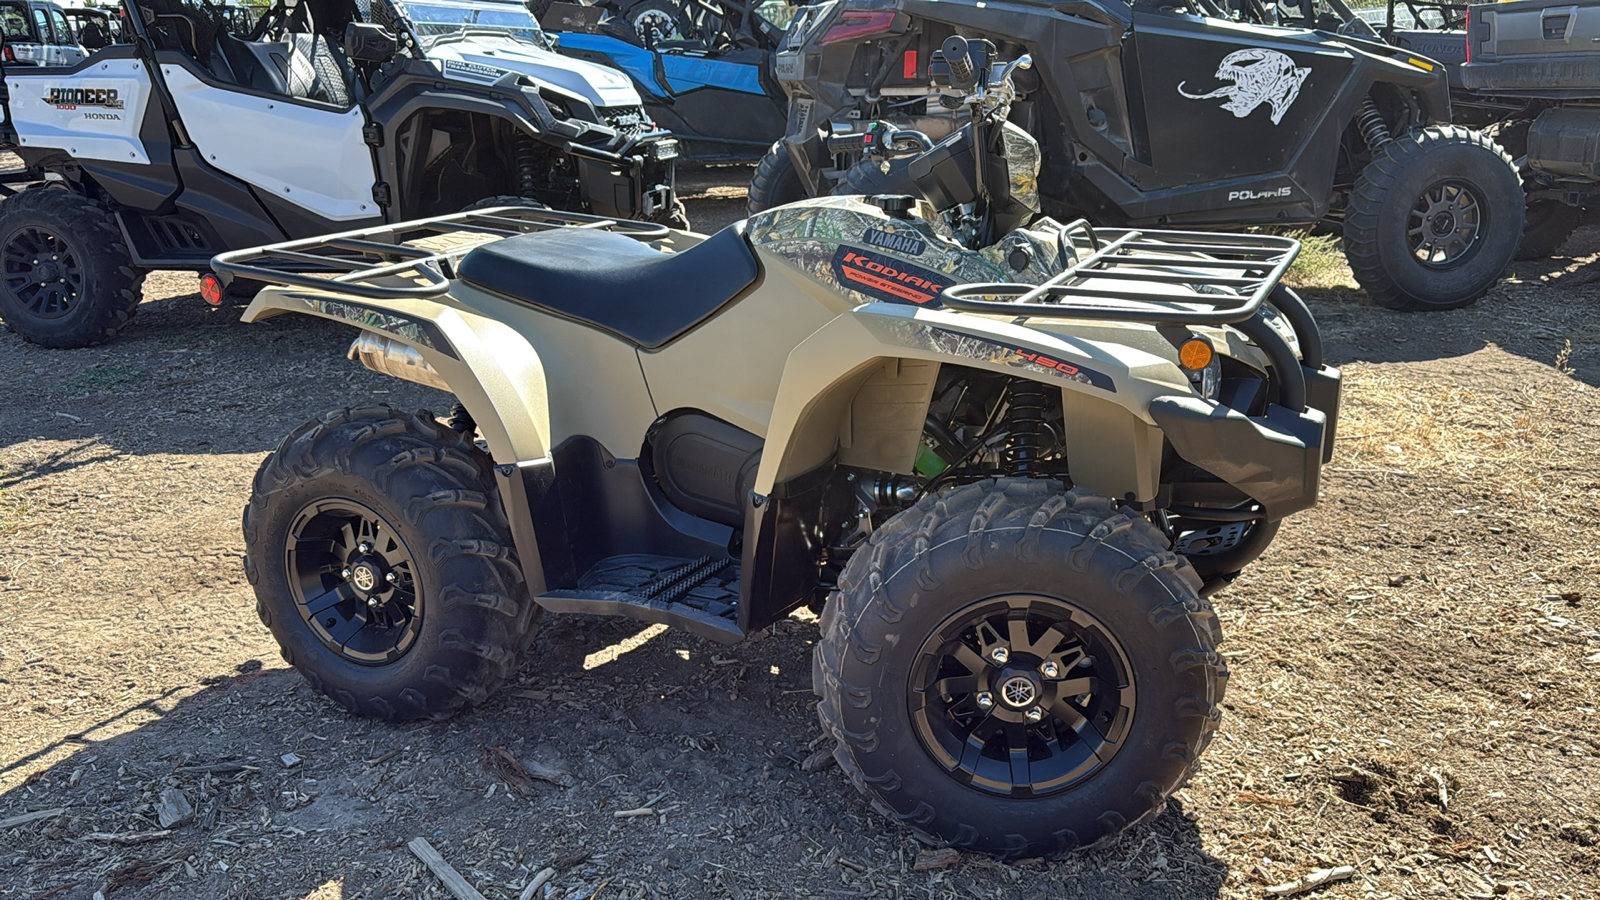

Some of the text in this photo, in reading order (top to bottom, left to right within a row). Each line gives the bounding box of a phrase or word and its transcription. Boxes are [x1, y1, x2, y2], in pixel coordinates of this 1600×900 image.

[447, 60, 497, 73] DUAL CLUTCH
[447, 64, 501, 77] TRANSMISSION
[50, 87, 118, 105] PIONEER
[83, 112, 121, 121] HONDA
[1228, 186, 1292, 202] POLARIS
[869, 230, 921, 255] YAMAHA
[842, 252, 943, 294] KODIAK
[849, 271, 923, 300] POWER STEERING
[1015, 348, 1079, 376] 450
